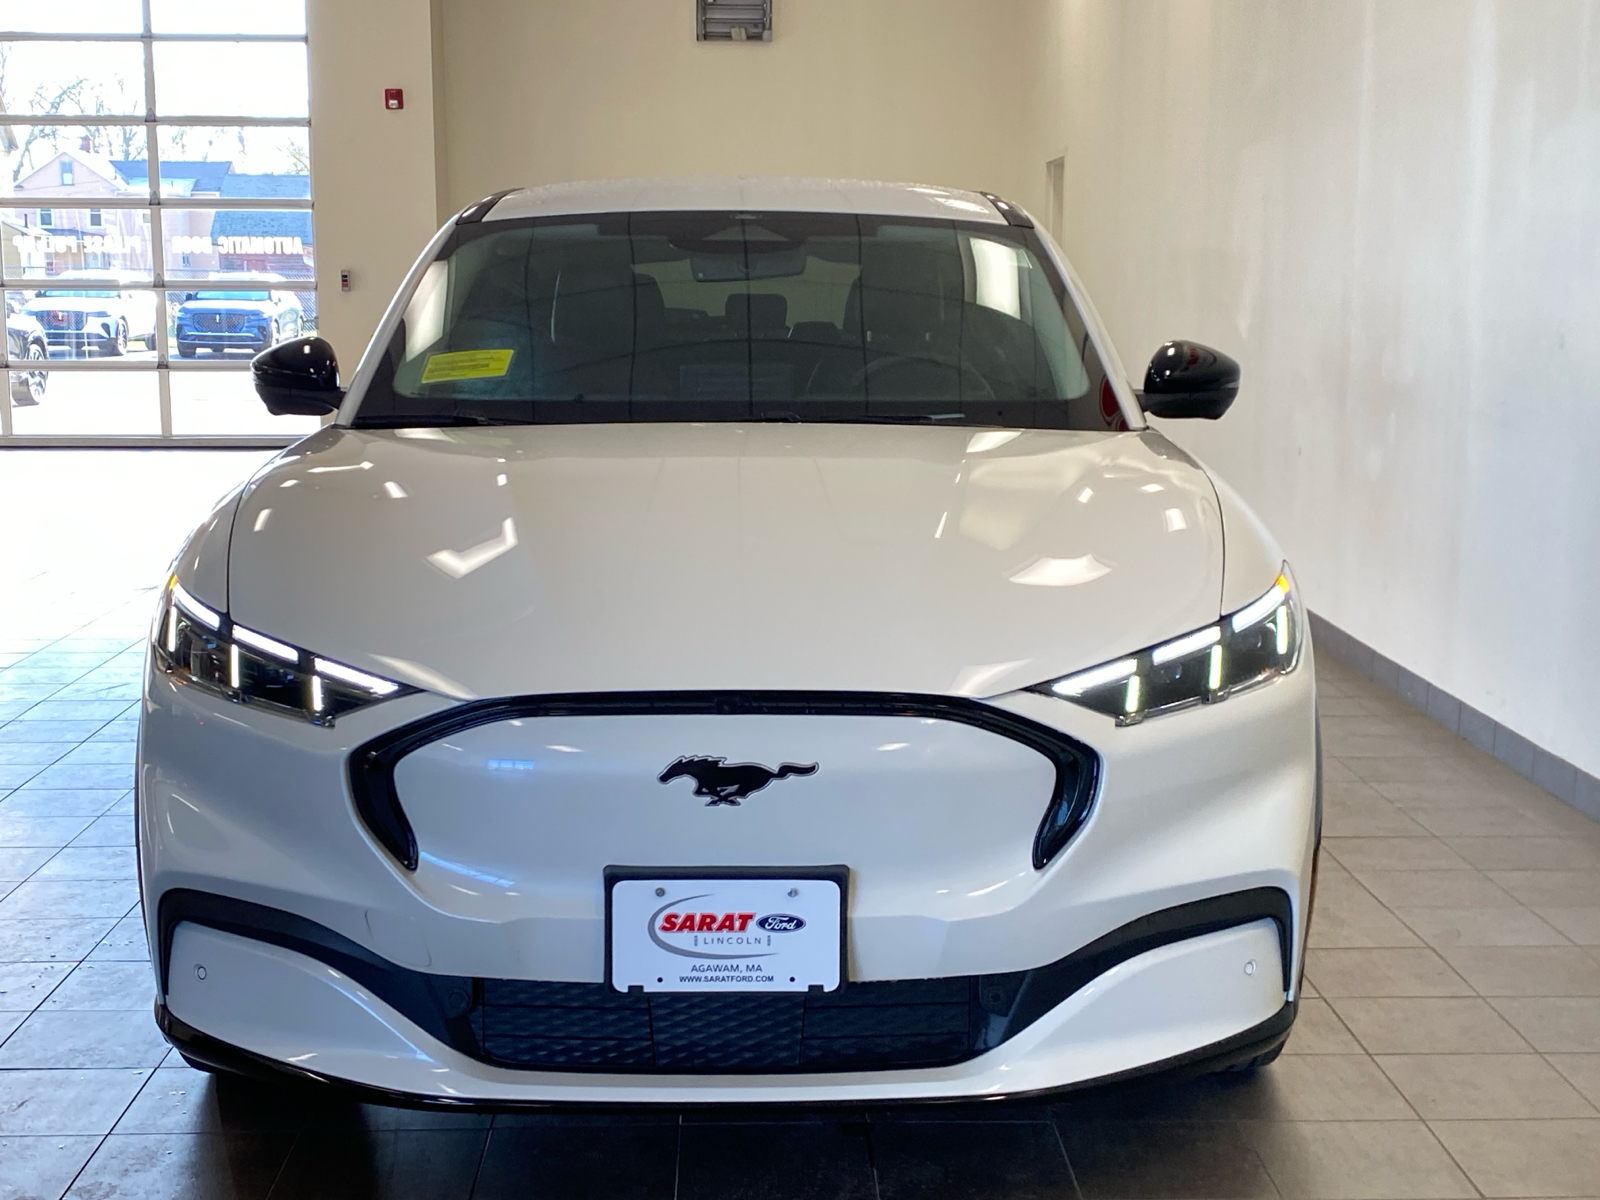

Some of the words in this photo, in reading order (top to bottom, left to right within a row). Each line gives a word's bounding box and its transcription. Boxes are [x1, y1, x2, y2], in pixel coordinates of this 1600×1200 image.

[658, 912, 757, 933] SARAT
[764, 915, 798, 931] Ford
[703, 936, 762, 945] LINCOLN
[690, 964, 743, 974] AGAWAM,
[745, 964, 763, 973] MA
[679, 975, 774, 983] WWW.SARATFORD.COM
